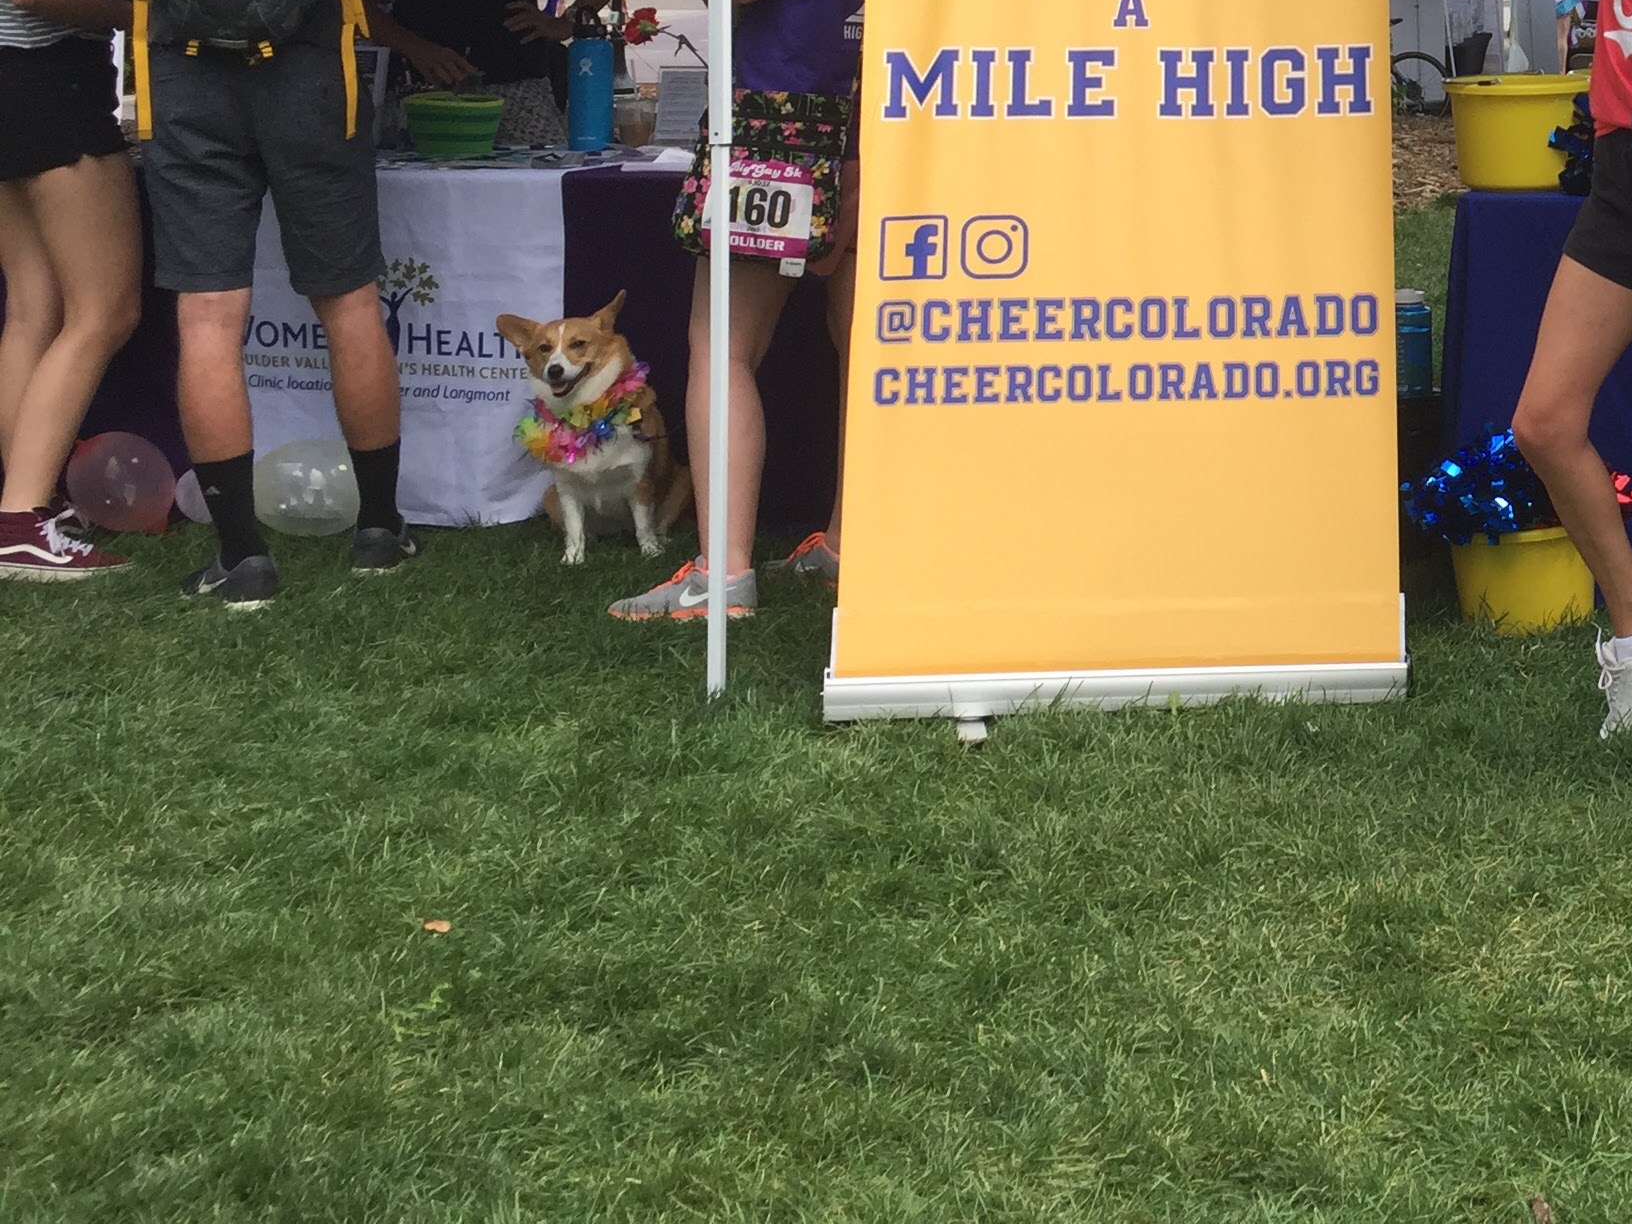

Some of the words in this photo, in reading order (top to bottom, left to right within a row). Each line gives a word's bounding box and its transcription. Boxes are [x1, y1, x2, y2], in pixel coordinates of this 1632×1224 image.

[843, 25, 863, 40] HIG
[881, 46, 1118, 121] MILE
[1157, 43, 1376, 119] HIGH
[729, 234, 785, 252] OULDER
[243, 315, 329, 350] OME
[875, 293, 1379, 344] @CHEERCOLORADO
[243, 353, 291, 369] ULDER
[294, 356, 329, 370] VALL
[421, 363, 475, 378] HEALTH
[479, 366, 529, 380] CENTE
[248, 374, 283, 389] Clinic
[287, 375, 333, 392] locatio
[413, 385, 441, 398] and
[443, 385, 511, 404] Longmont
[873, 359, 1380, 407] CHEERCOLORADO.ORG
